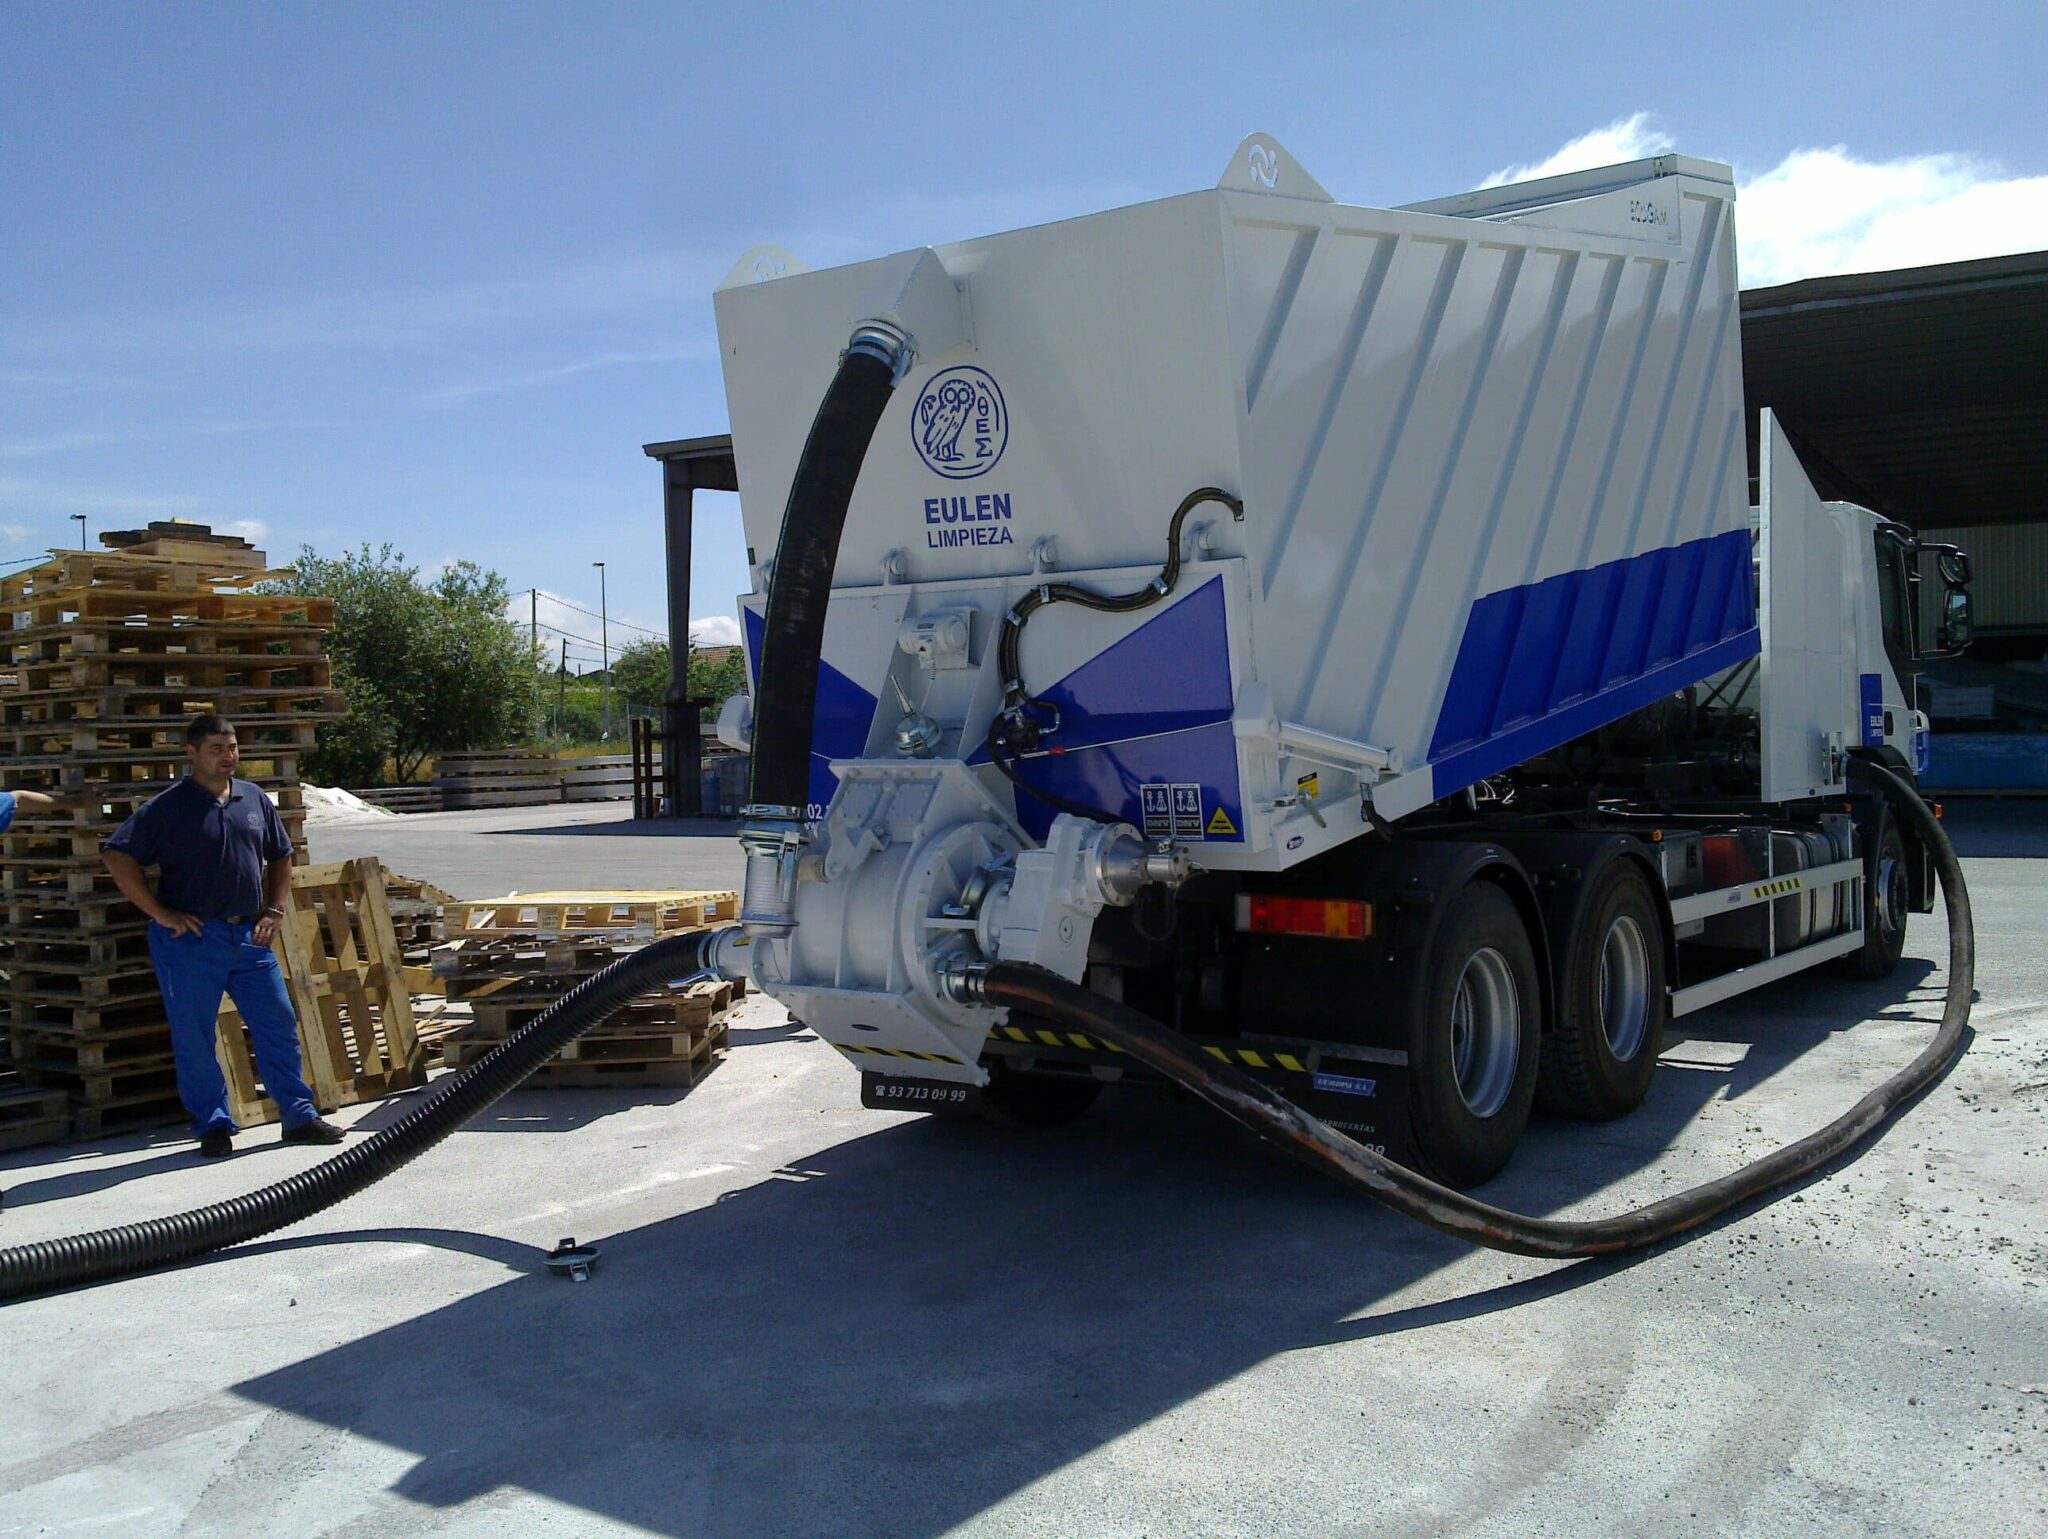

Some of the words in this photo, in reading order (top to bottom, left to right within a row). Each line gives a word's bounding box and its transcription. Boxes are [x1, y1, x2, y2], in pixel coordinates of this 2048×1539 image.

[924, 493, 1012, 524] EULEN
[928, 526, 1013, 548] LIMPIEZA
[888, 1086, 904, 1098] 93
[905, 1087, 929, 1100] 713
[950, 1089, 966, 1102] 99
